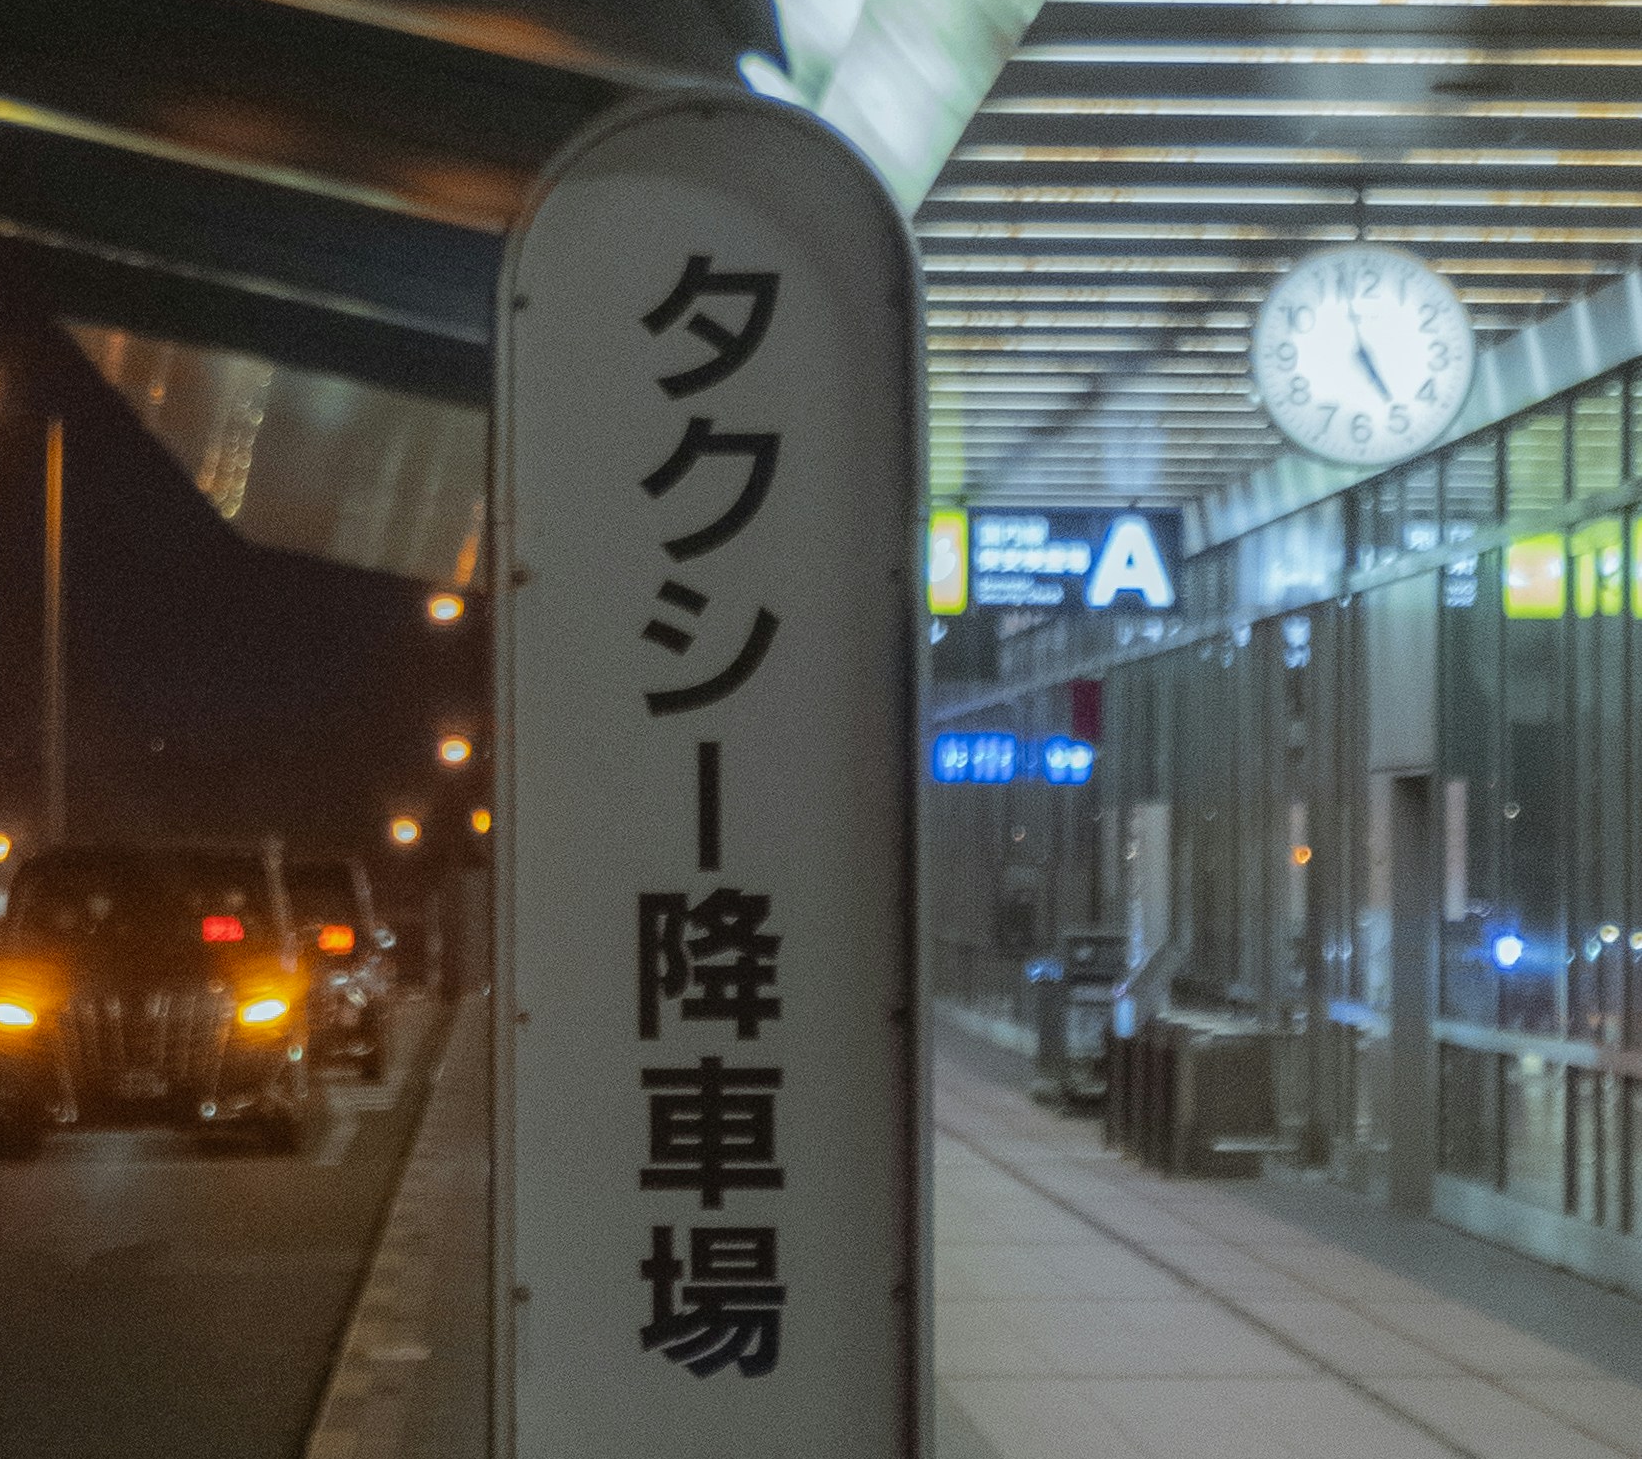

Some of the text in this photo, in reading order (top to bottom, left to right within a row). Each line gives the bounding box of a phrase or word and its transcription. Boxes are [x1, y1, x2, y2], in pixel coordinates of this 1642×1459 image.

[1278, 304, 1315, 334] 10
[1418, 303, 1439, 334] 2
[1276, 341, 1298, 373] 9
[1427, 341, 1449, 373] 3
[1289, 375, 1311, 406] 8
[1414, 377, 1437, 405] 4
[1317, 403, 1340, 435] 7
[1351, 413, 1373, 445] 6
[1388, 403, 1410, 435] 5
[1088, 517, 1173, 608] A
[639, 254, 787, 1380] タクシー降車場
